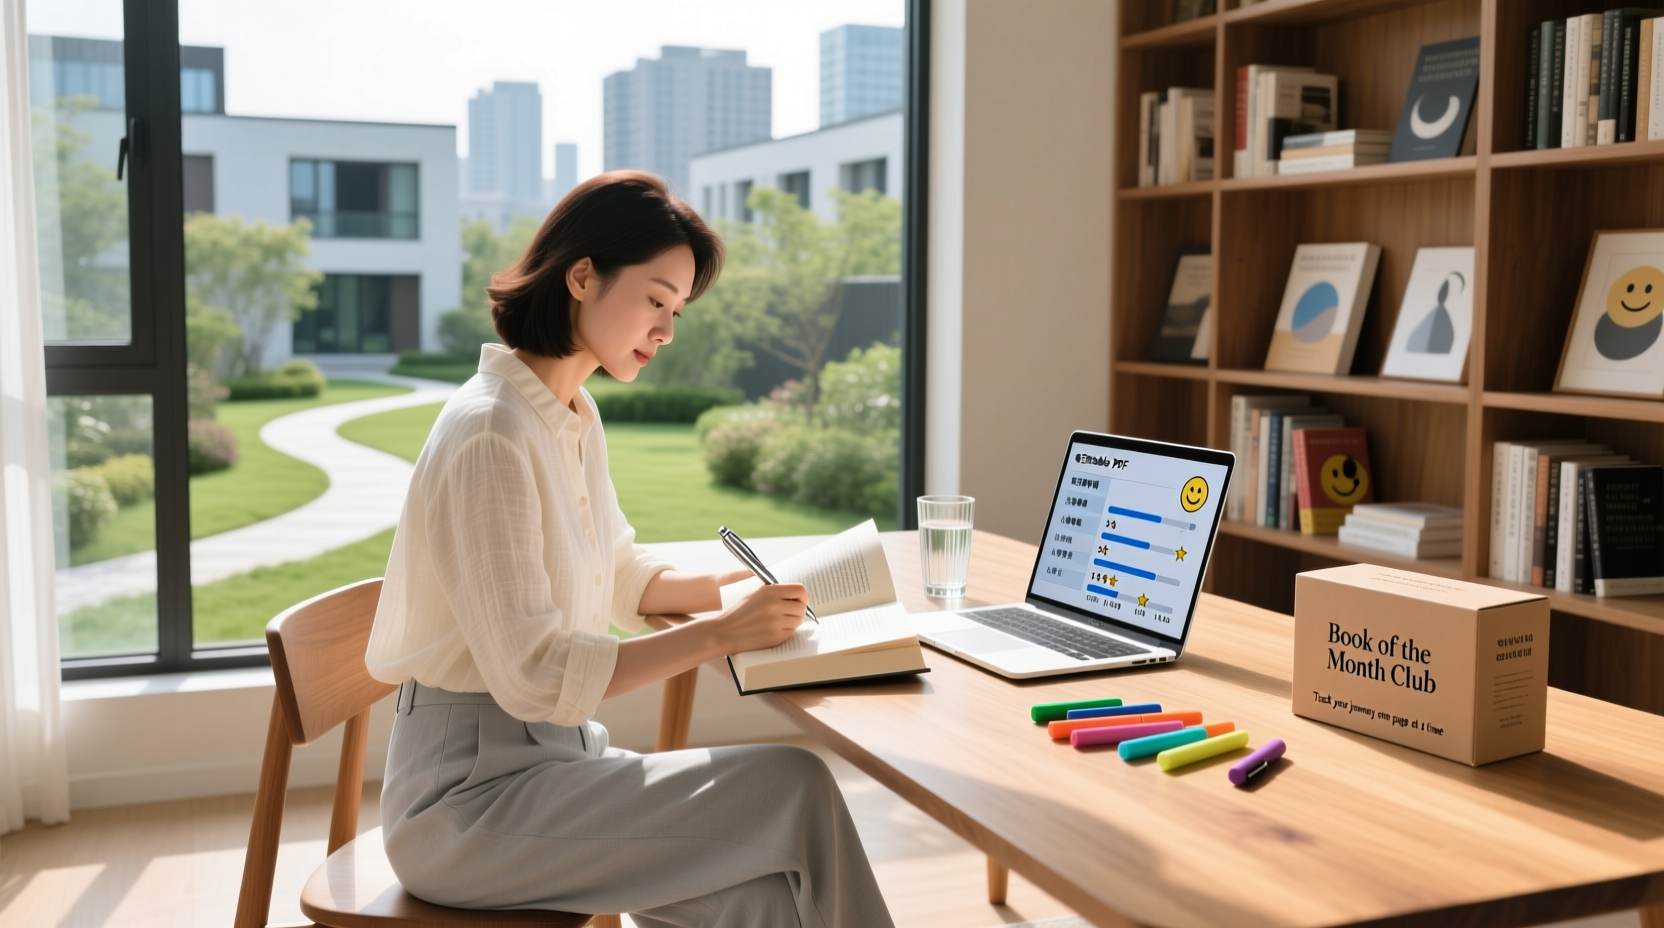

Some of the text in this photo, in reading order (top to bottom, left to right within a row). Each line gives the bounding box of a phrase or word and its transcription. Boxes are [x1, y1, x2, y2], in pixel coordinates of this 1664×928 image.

[1328, 621, 1431, 665] Book of the
[1327, 647, 1437, 694] Month Club
